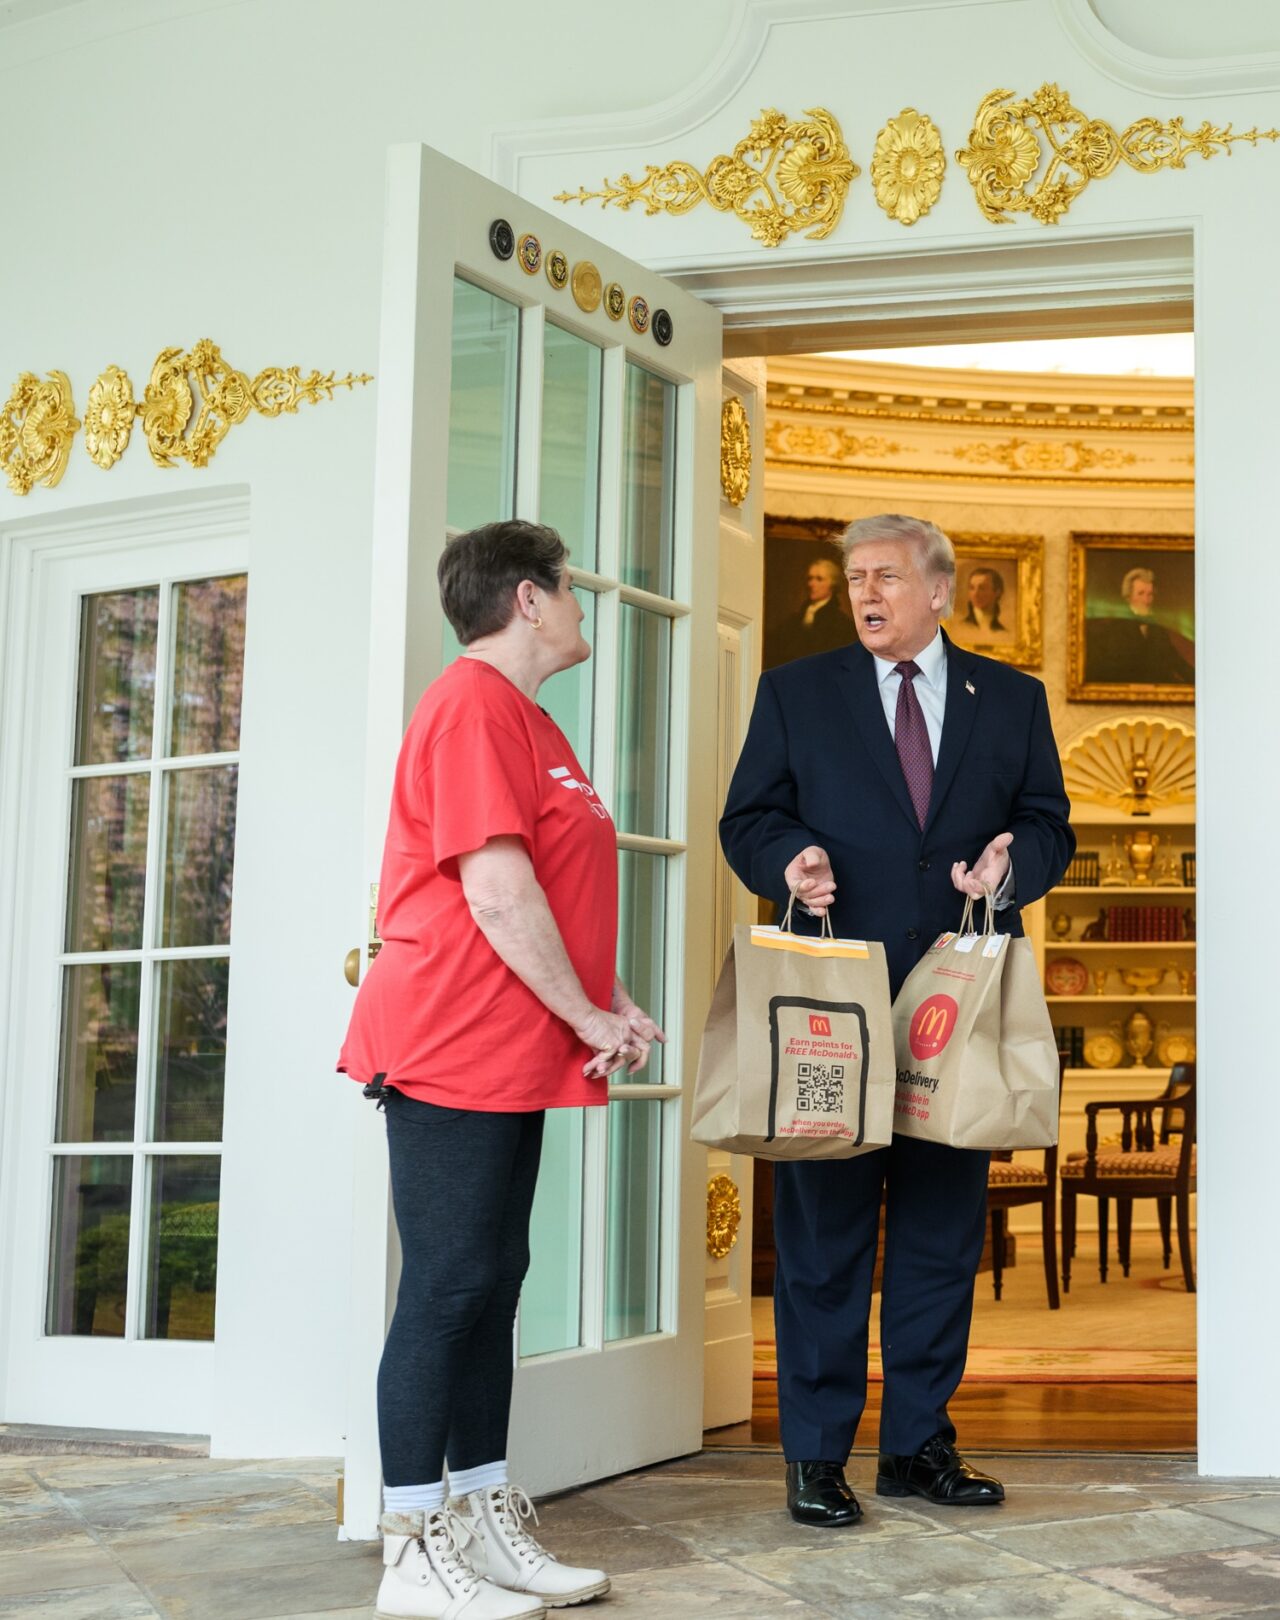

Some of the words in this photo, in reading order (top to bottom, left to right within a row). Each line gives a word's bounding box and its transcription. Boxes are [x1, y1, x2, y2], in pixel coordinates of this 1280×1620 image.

[790, 1037, 810, 1046] Earn
[811, 1040, 840, 1049] points
[840, 1042, 853, 1050] for
[785, 1047, 807, 1056] FREE
[809, 1048, 858, 1060] McDonald's
[813, 1120, 826, 1128] you
